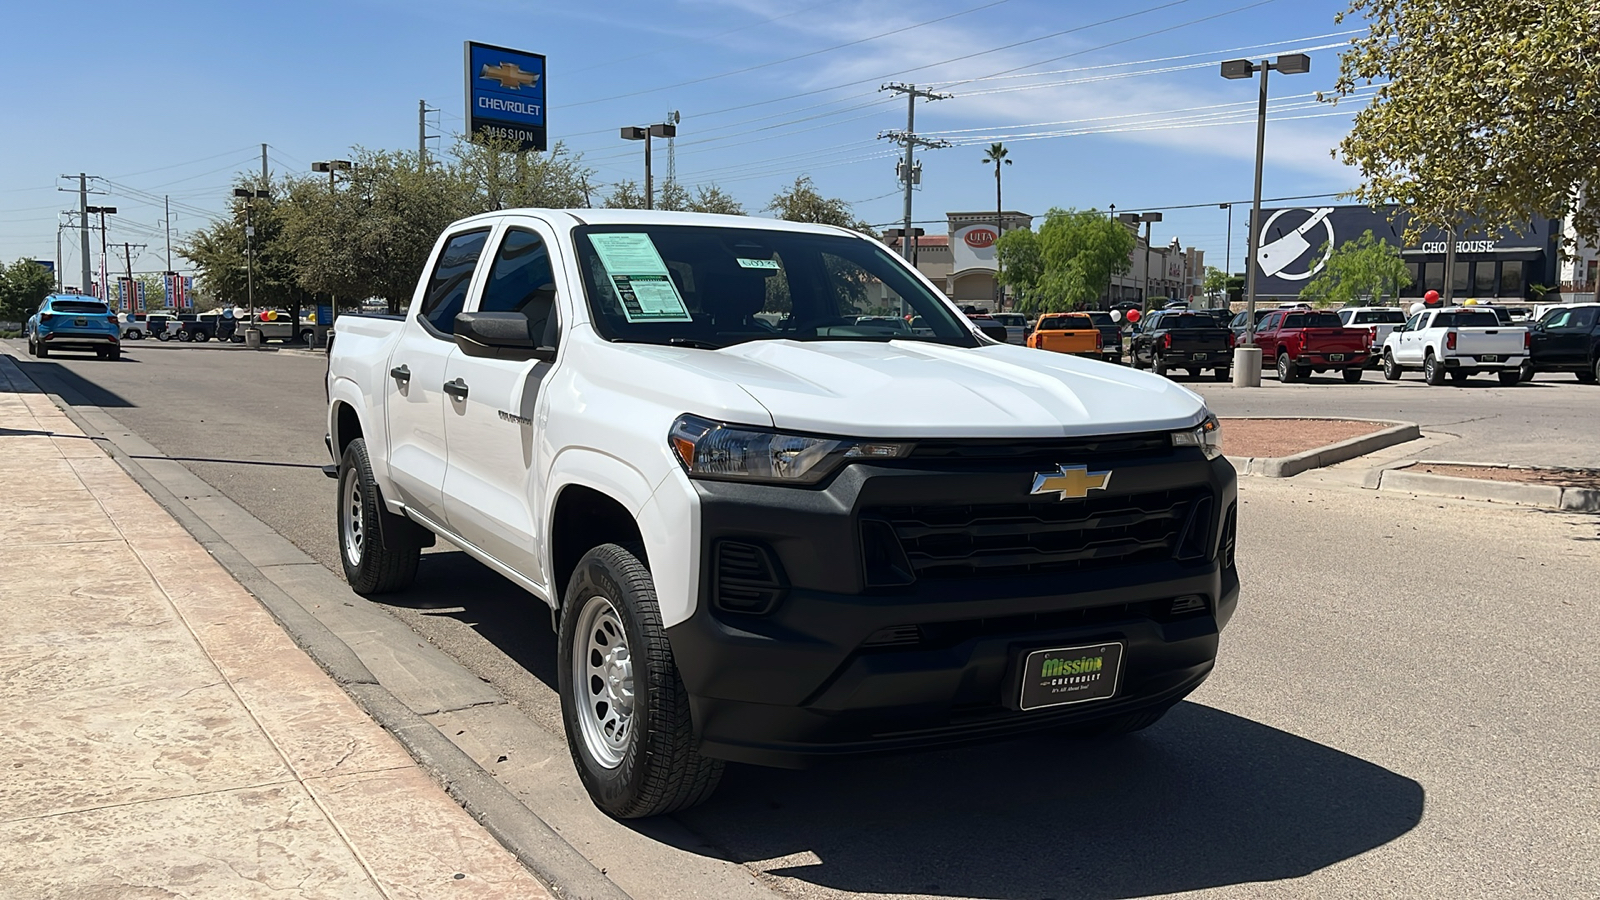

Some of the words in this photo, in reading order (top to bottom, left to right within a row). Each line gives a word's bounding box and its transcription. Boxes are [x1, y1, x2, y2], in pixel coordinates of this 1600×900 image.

[479, 97, 541, 115] CHEVROLET
[487, 126, 533, 141] MISSION
[970, 232, 993, 240] ULTA
[1422, 241, 1494, 253] CHOHOUSE
[1041, 656, 1103, 678] Mission
[1051, 673, 1101, 686] CHEVROLET
